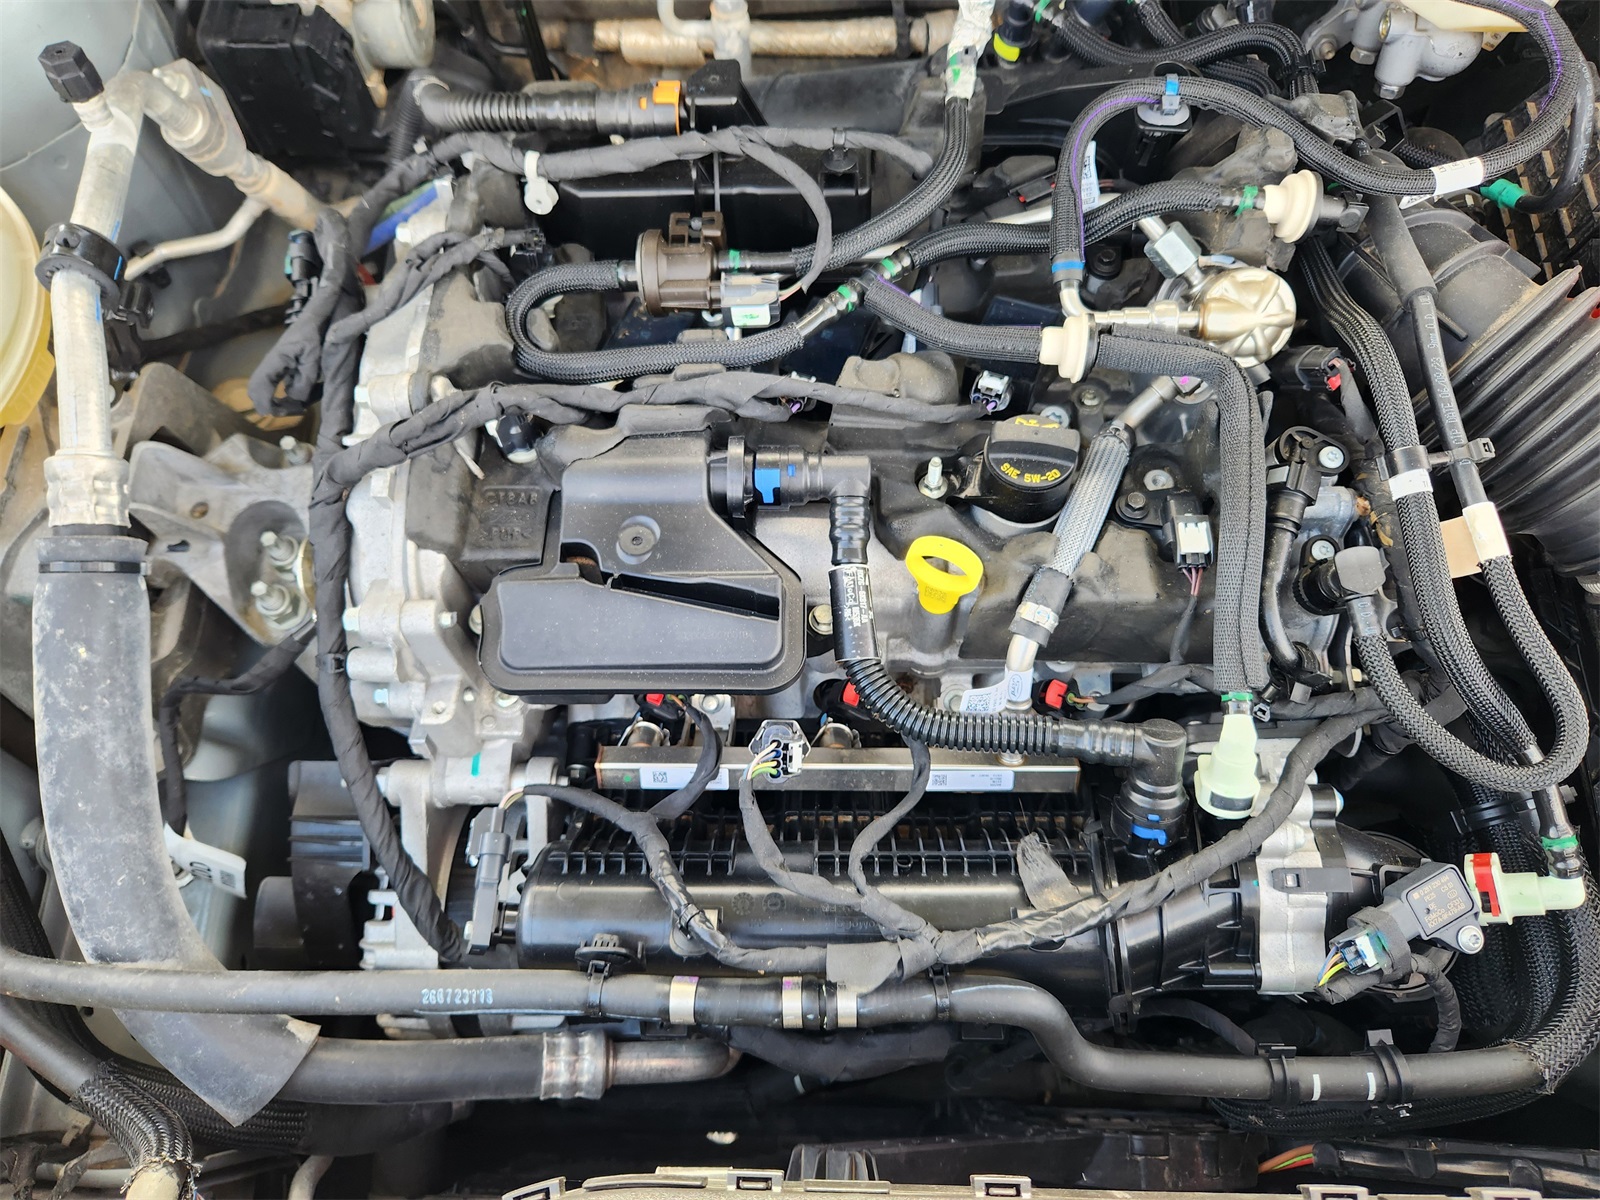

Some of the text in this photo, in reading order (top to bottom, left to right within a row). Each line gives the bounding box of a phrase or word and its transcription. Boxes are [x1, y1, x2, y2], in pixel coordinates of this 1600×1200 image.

[1441, 404, 1458, 424] DATE
[1000, 462, 1061, 483] SAE 5W-20
[1424, 908, 1445, 921] FoMoCo
